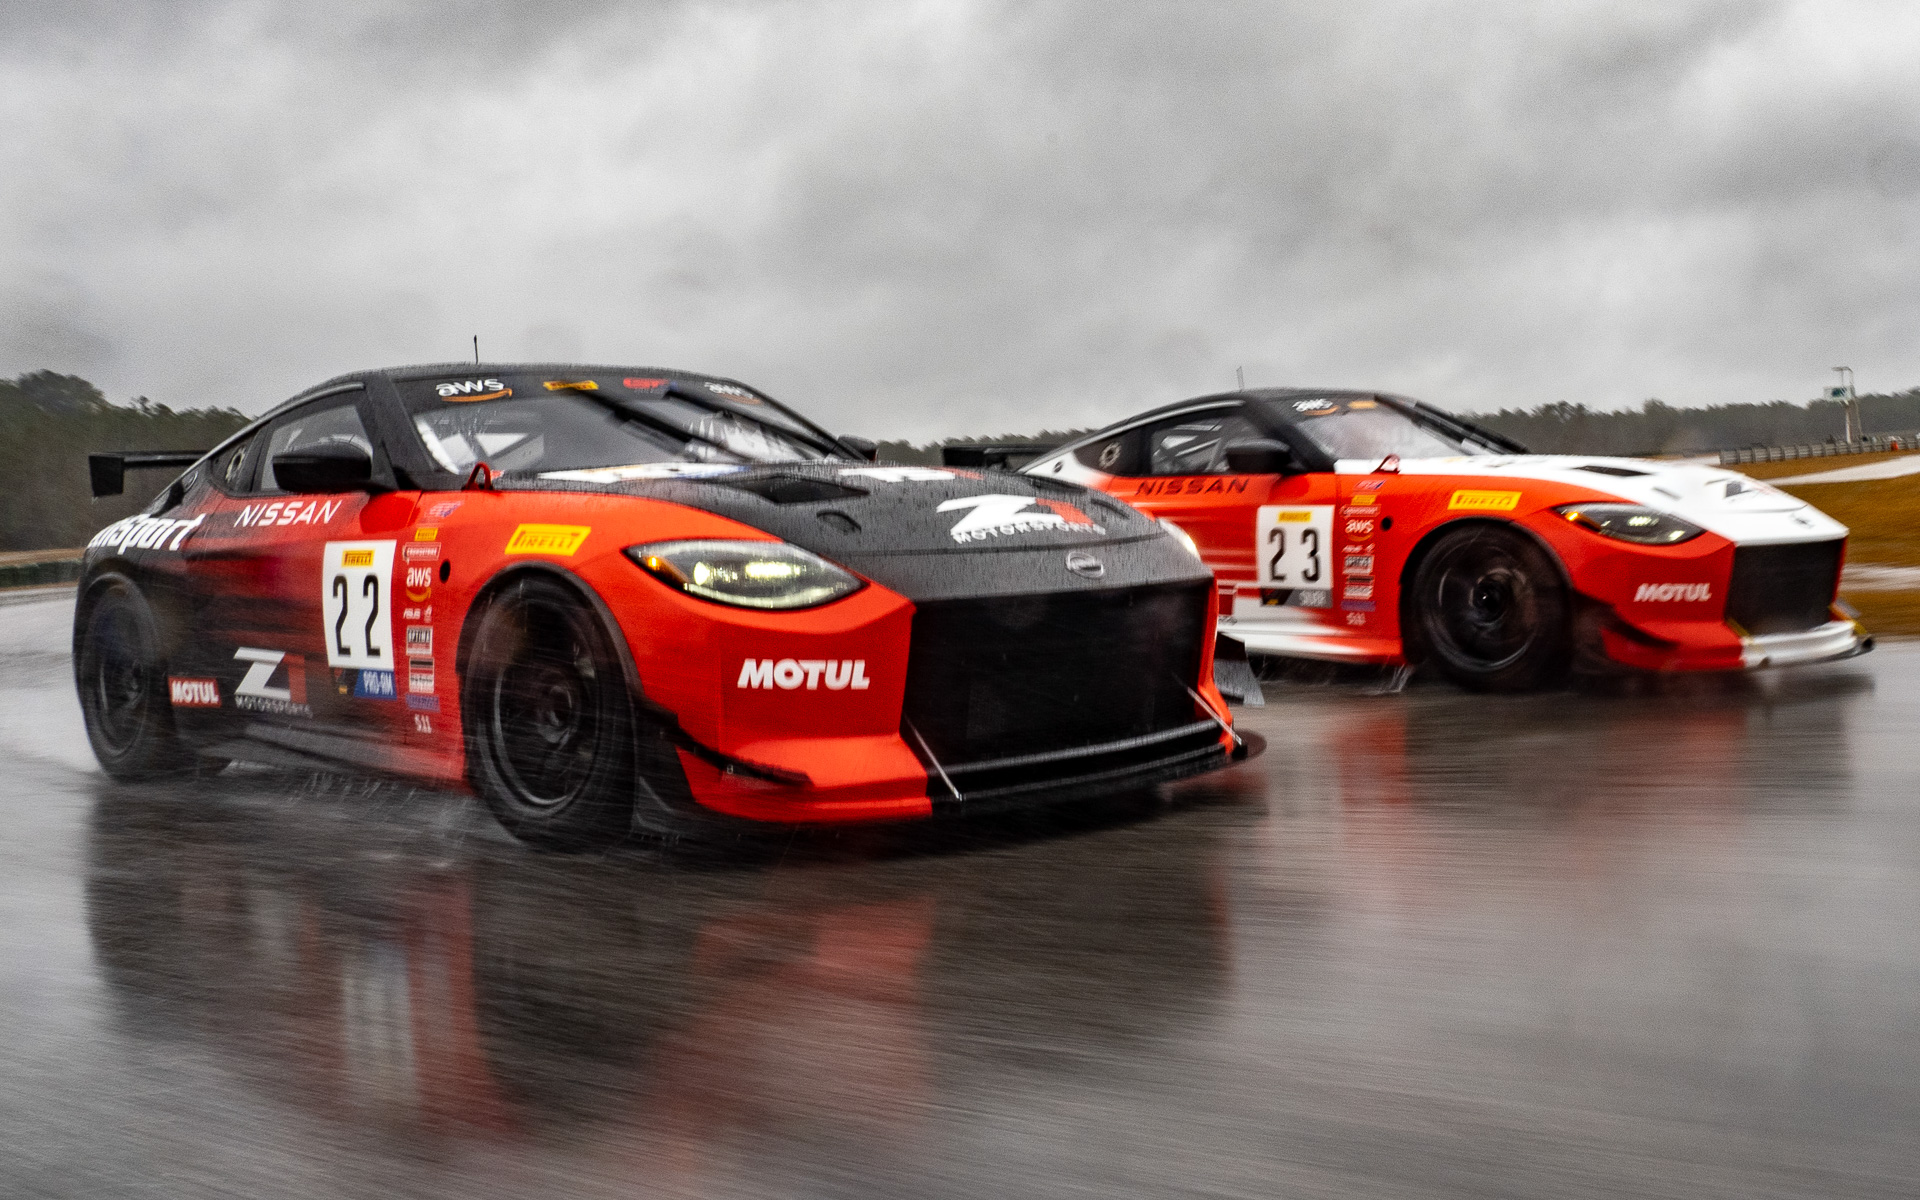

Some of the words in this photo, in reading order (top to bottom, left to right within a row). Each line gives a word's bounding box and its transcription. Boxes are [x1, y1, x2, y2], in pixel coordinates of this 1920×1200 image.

[436, 378, 504, 397] aws
[1135, 476, 1250, 496] NISSAN
[233, 500, 343, 529] NISSAN
[513, 529, 581, 550] PIRELLI
[343, 551, 373, 566] PIRELLI
[1268, 527, 1320, 583] 23
[406, 566, 432, 588] aws
[1633, 582, 1713, 602] MOTUL
[332, 573, 381, 658] 22
[737, 657, 871, 691] MOTUL
[171, 680, 220, 704] MOTUL
